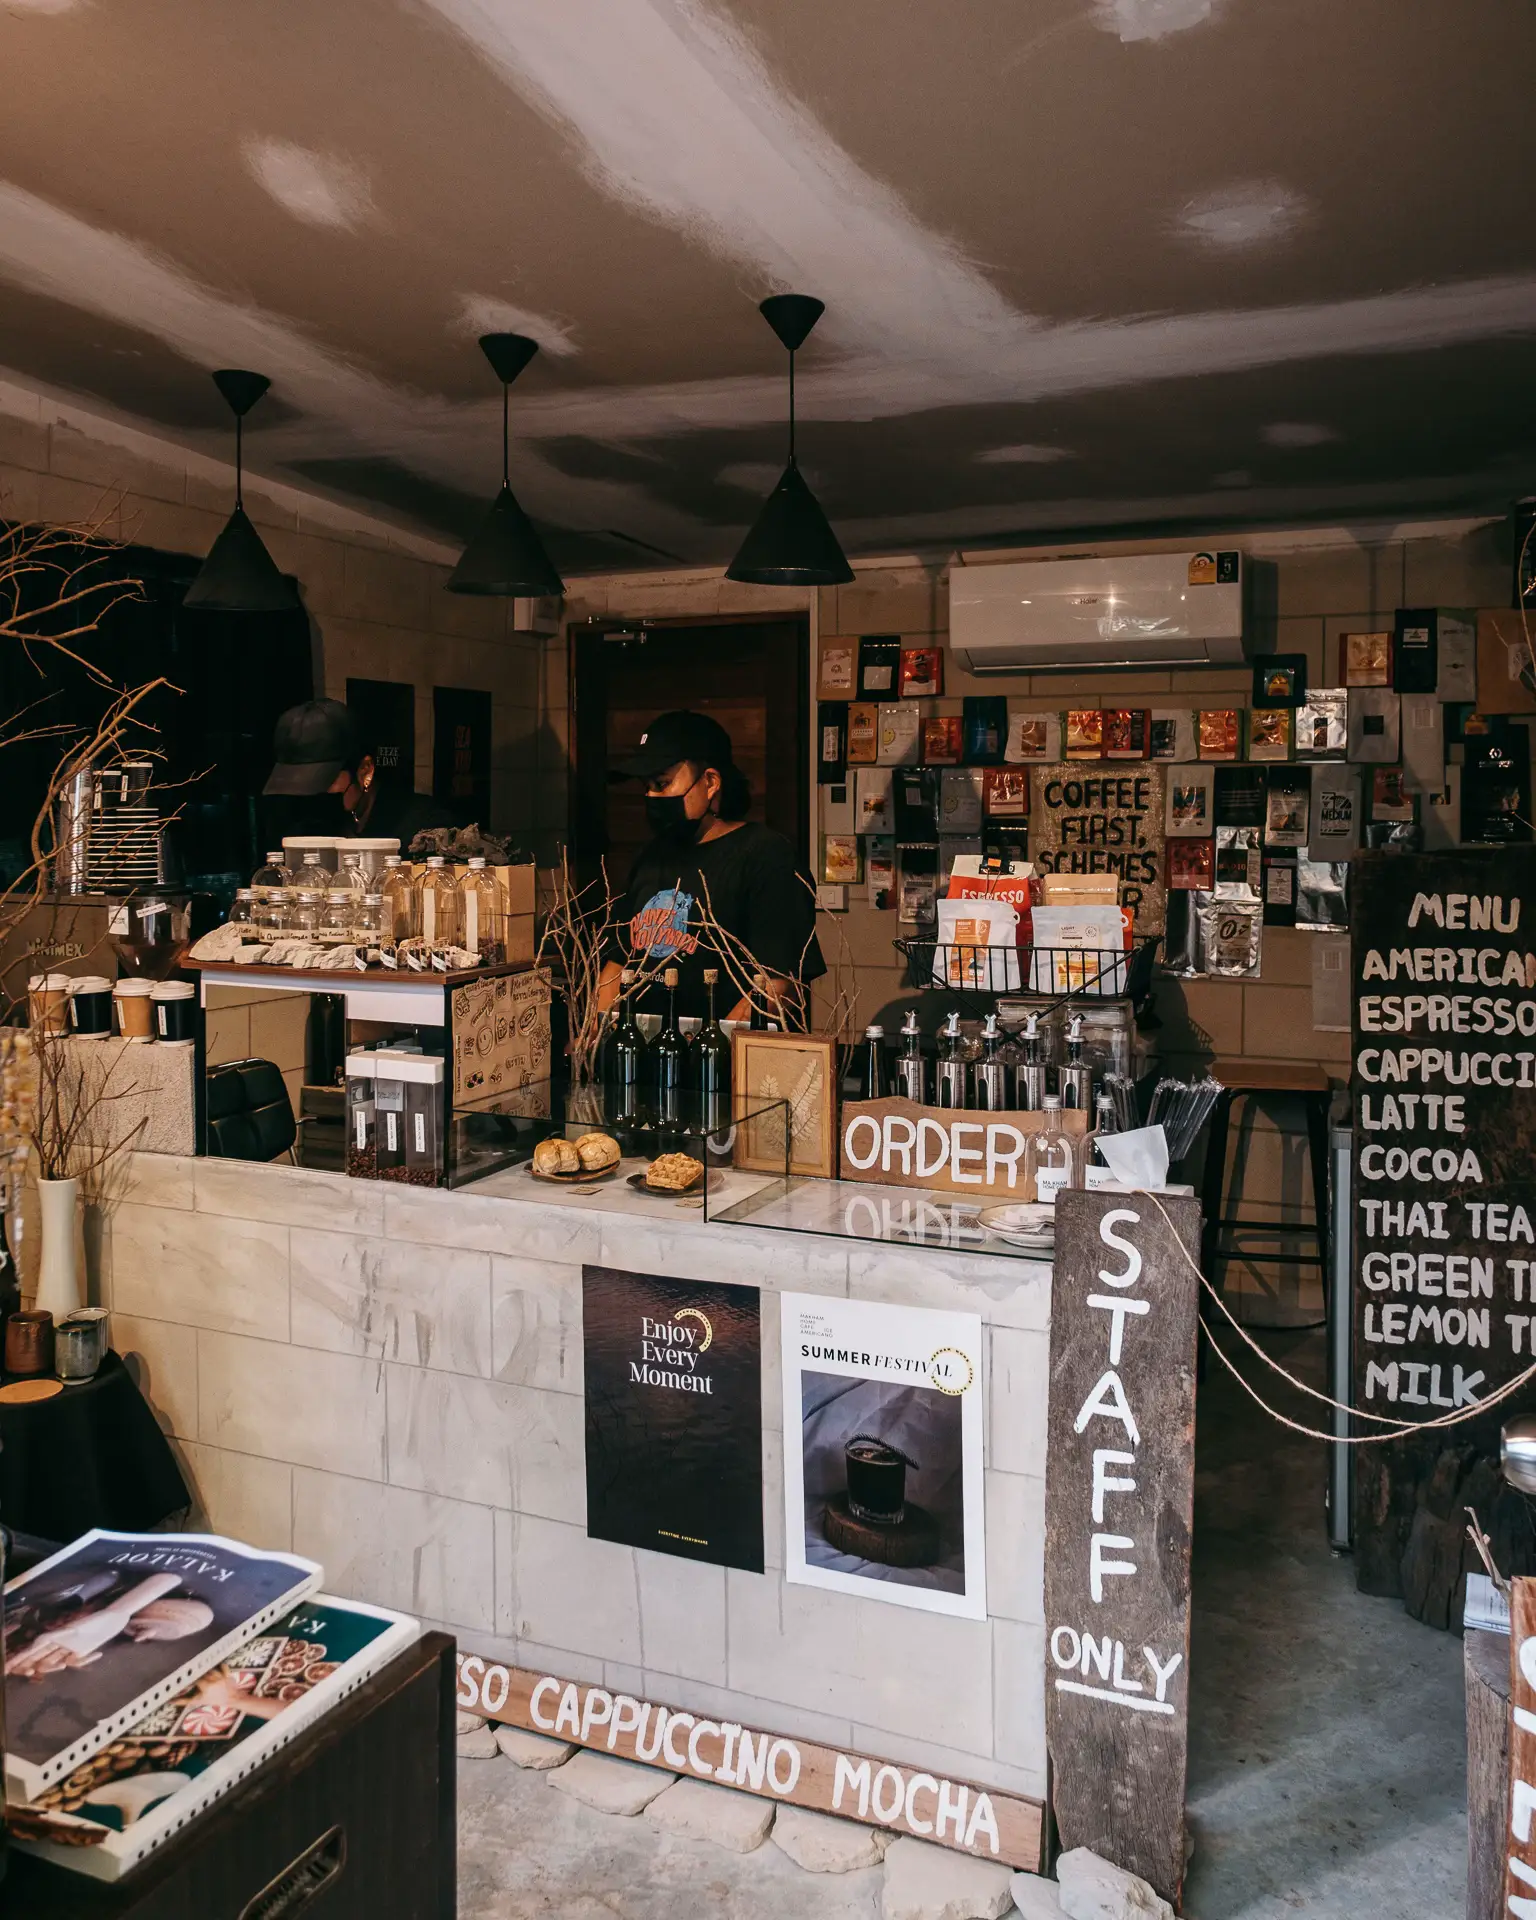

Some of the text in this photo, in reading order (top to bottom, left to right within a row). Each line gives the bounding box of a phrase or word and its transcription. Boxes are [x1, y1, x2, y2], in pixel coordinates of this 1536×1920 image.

[1080, 597, 1098, 605] Haier
[1044, 778, 1150, 810] COFFEE
[1060, 814, 1147, 848] FIRST,
[1321, 808, 1352, 821] MEDIUM
[1038, 850, 1158, 884] SCHEMES
[1407, 892, 1520, 933] MENU
[1359, 995, 1536, 1037] ESPRESSO
[1357, 1048, 1536, 1089] CAPPUCCI
[1361, 1094, 1466, 1133] LATTE
[844, 1115, 1026, 1188] ORDER
[1359, 1144, 1483, 1183] COCOA
[1359, 1199, 1535, 1244] THAI TEA
[1361, 1252, 1536, 1303] GREEN T
[641, 1316, 698, 1349] Enjoy
[1363, 1303, 1536, 1357] LEMON T
[641, 1340, 699, 1373] Every
[801, 1344, 953, 1378] SUMMER FESTIVAL
[628, 1361, 714, 1395] Moment
[1364, 1360, 1486, 1408] MILK
[1073, 1208, 1151, 1605] STAFF
[107, 1551, 236, 1583] KALALOU
[1051, 1625, 1183, 1703] ONLY
[530, 1676, 801, 1794] CAPPUCCINO
[832, 1754, 1000, 1853] MOCHA
